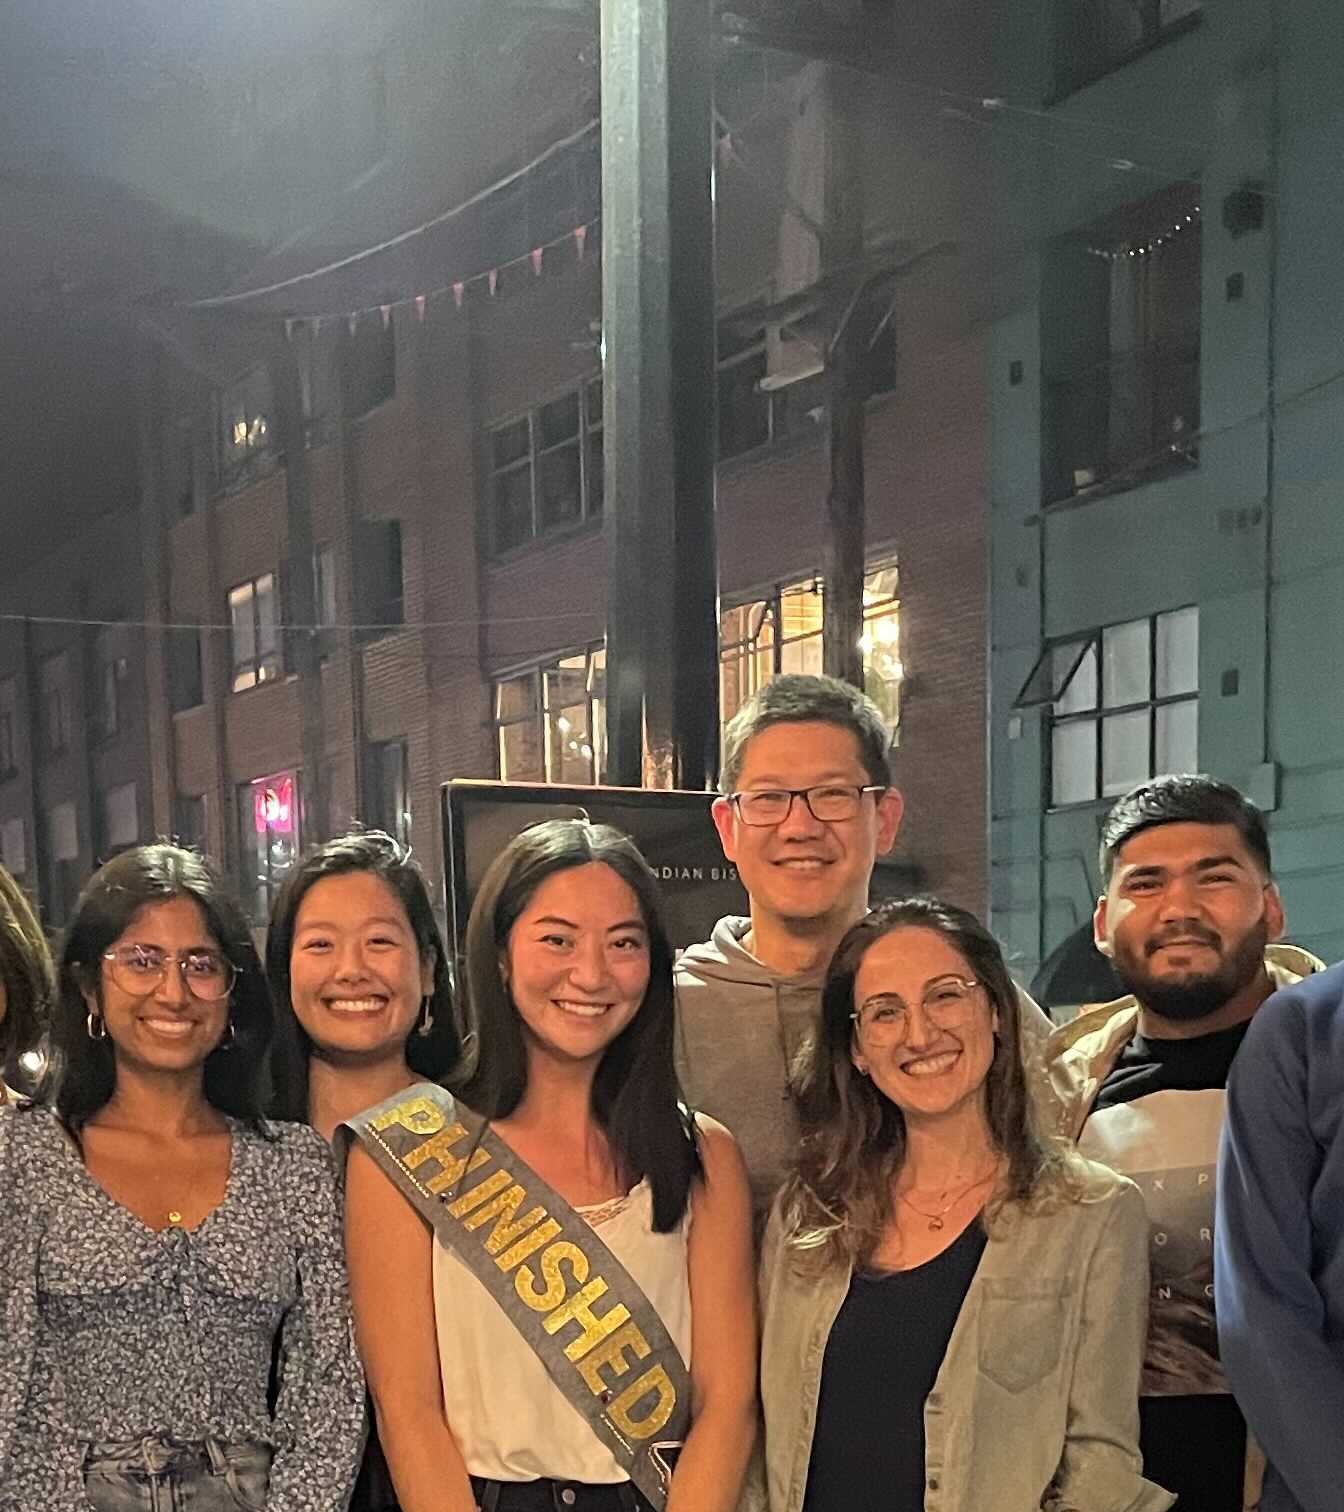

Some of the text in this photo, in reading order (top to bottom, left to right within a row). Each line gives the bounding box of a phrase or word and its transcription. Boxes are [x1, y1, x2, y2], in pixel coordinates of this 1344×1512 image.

[648, 866, 737, 881] NDIAN BIS
[367, 1097, 677, 1440] PHINISHED
